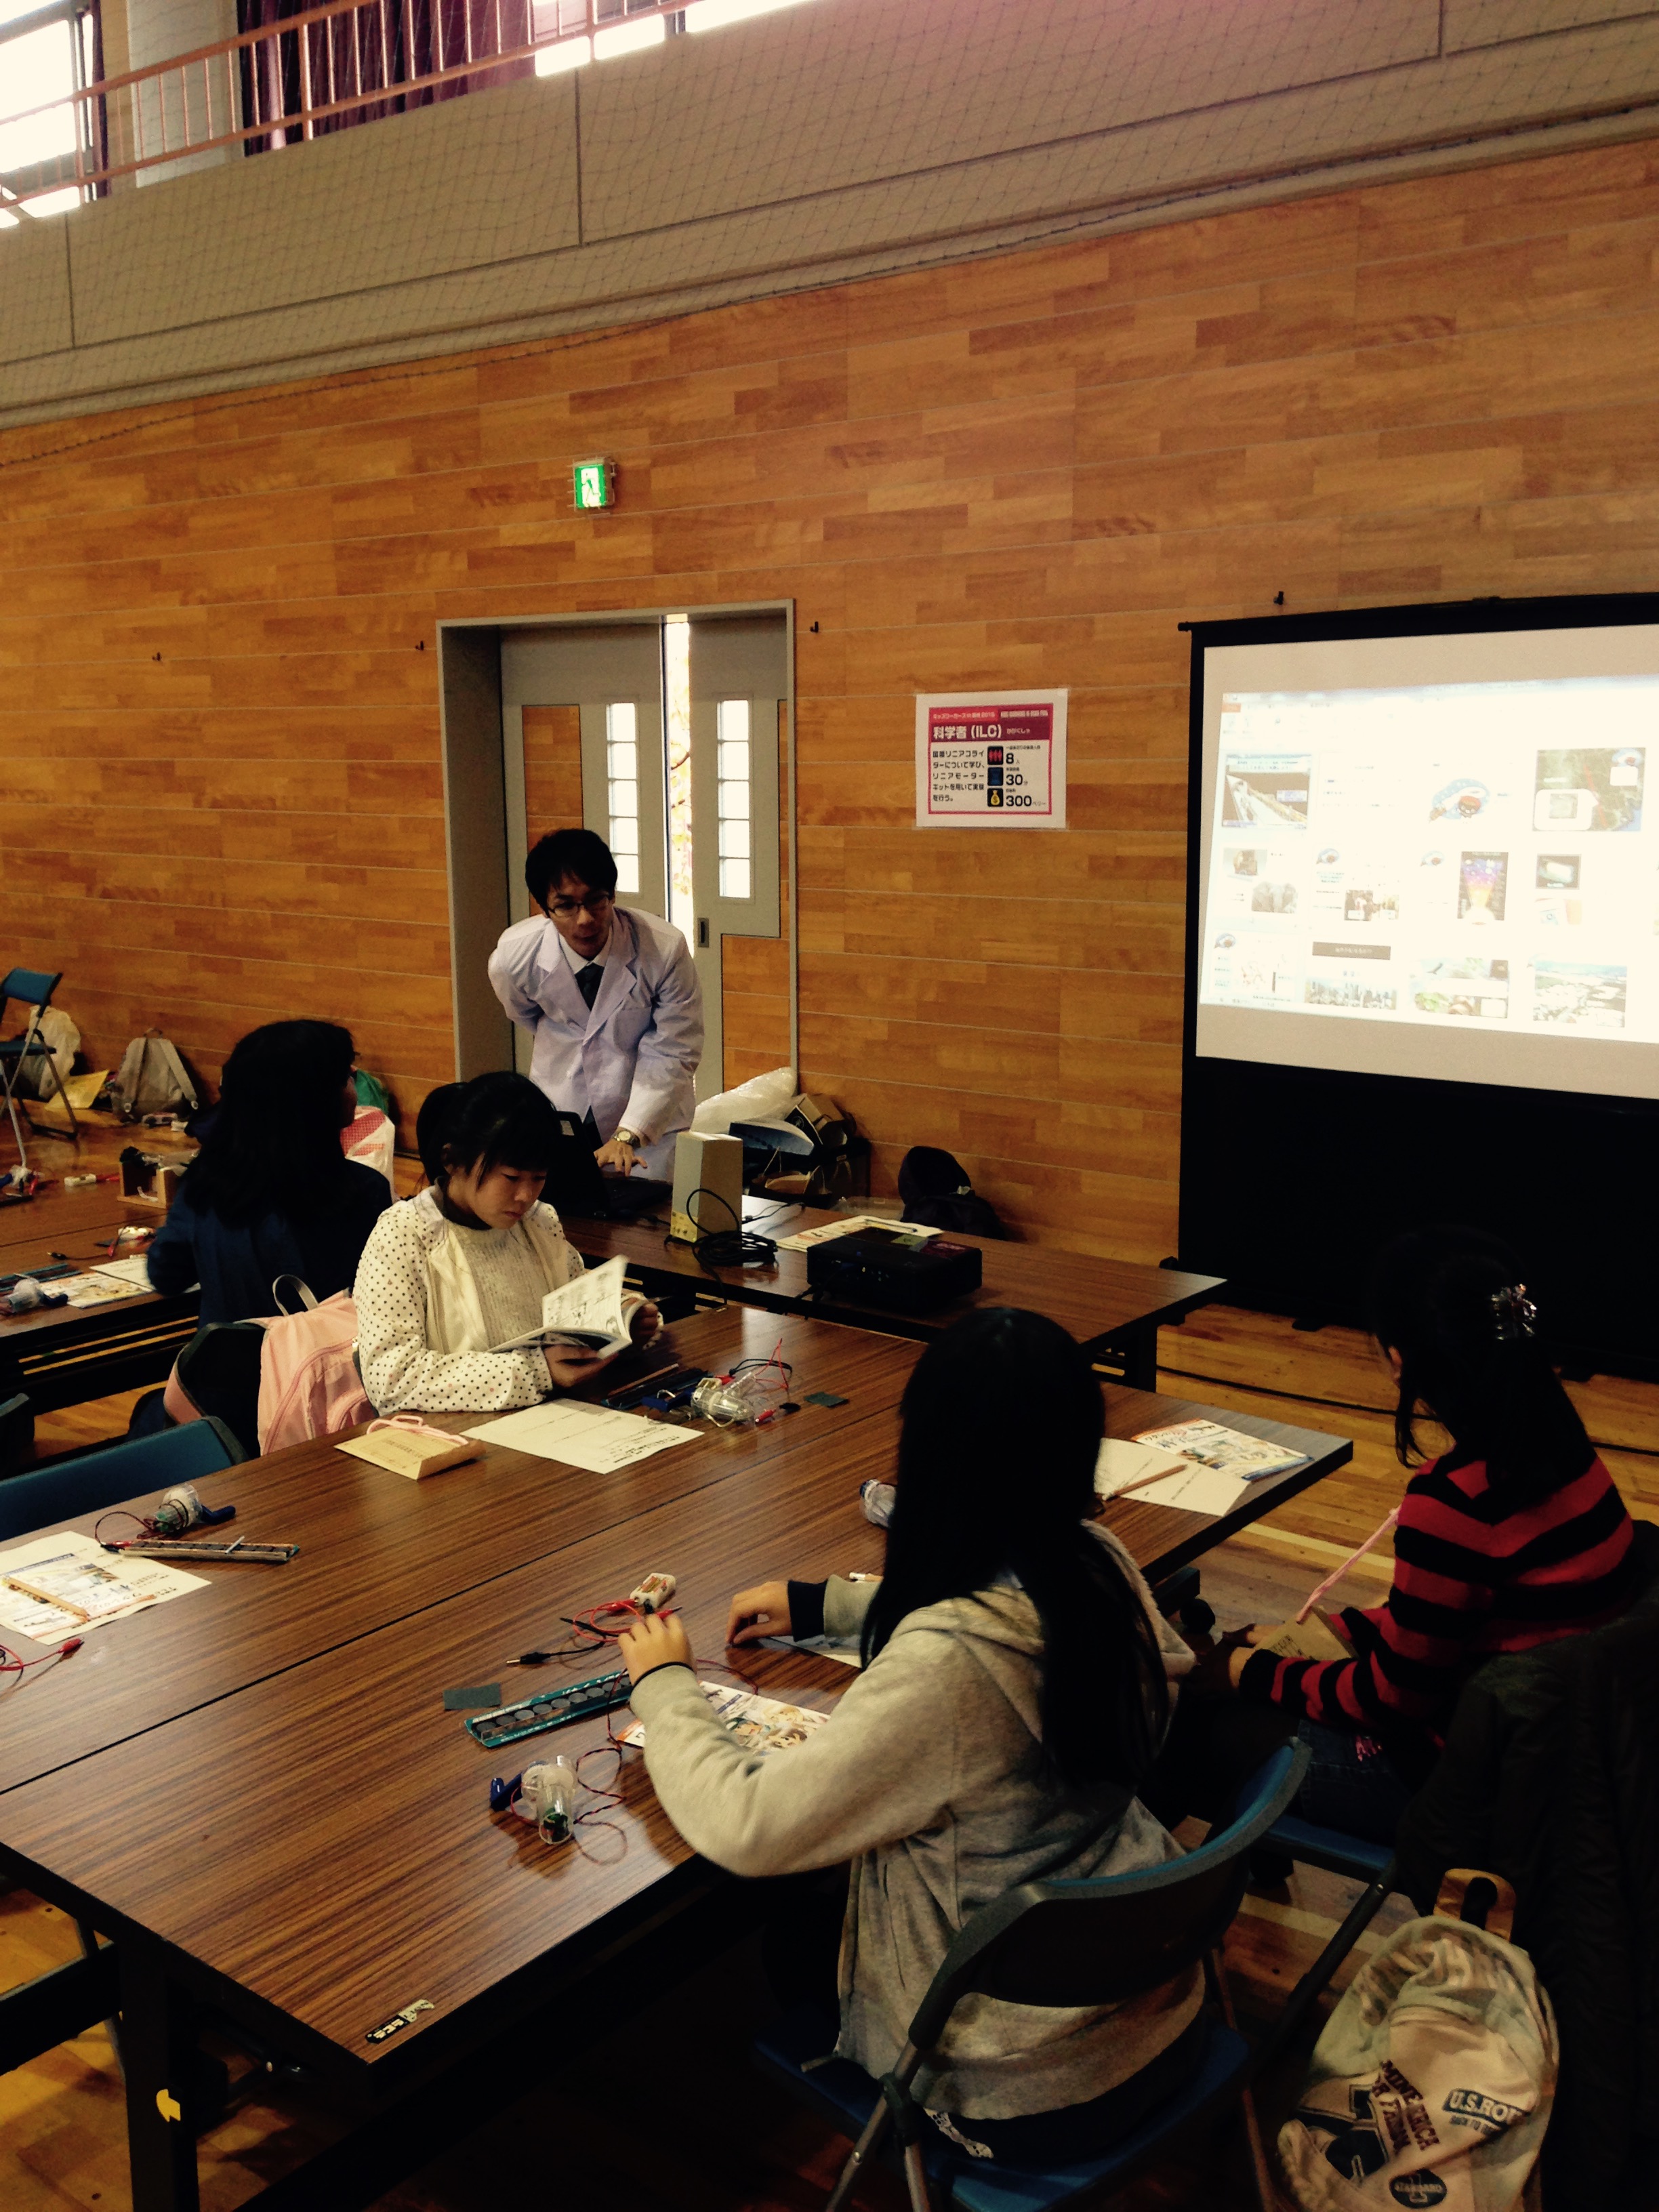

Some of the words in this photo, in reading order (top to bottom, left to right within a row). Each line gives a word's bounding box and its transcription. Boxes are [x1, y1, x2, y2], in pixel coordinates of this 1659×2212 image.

[933, 725, 966, 739] 科学者
[971, 724, 1002, 739] (ILC)
[933, 750, 985, 758] 国際リニアコライ
[933, 772, 985, 780] リニアモーター
[1006, 774, 1023, 786] 30
[1006, 795, 1032, 806] 300
